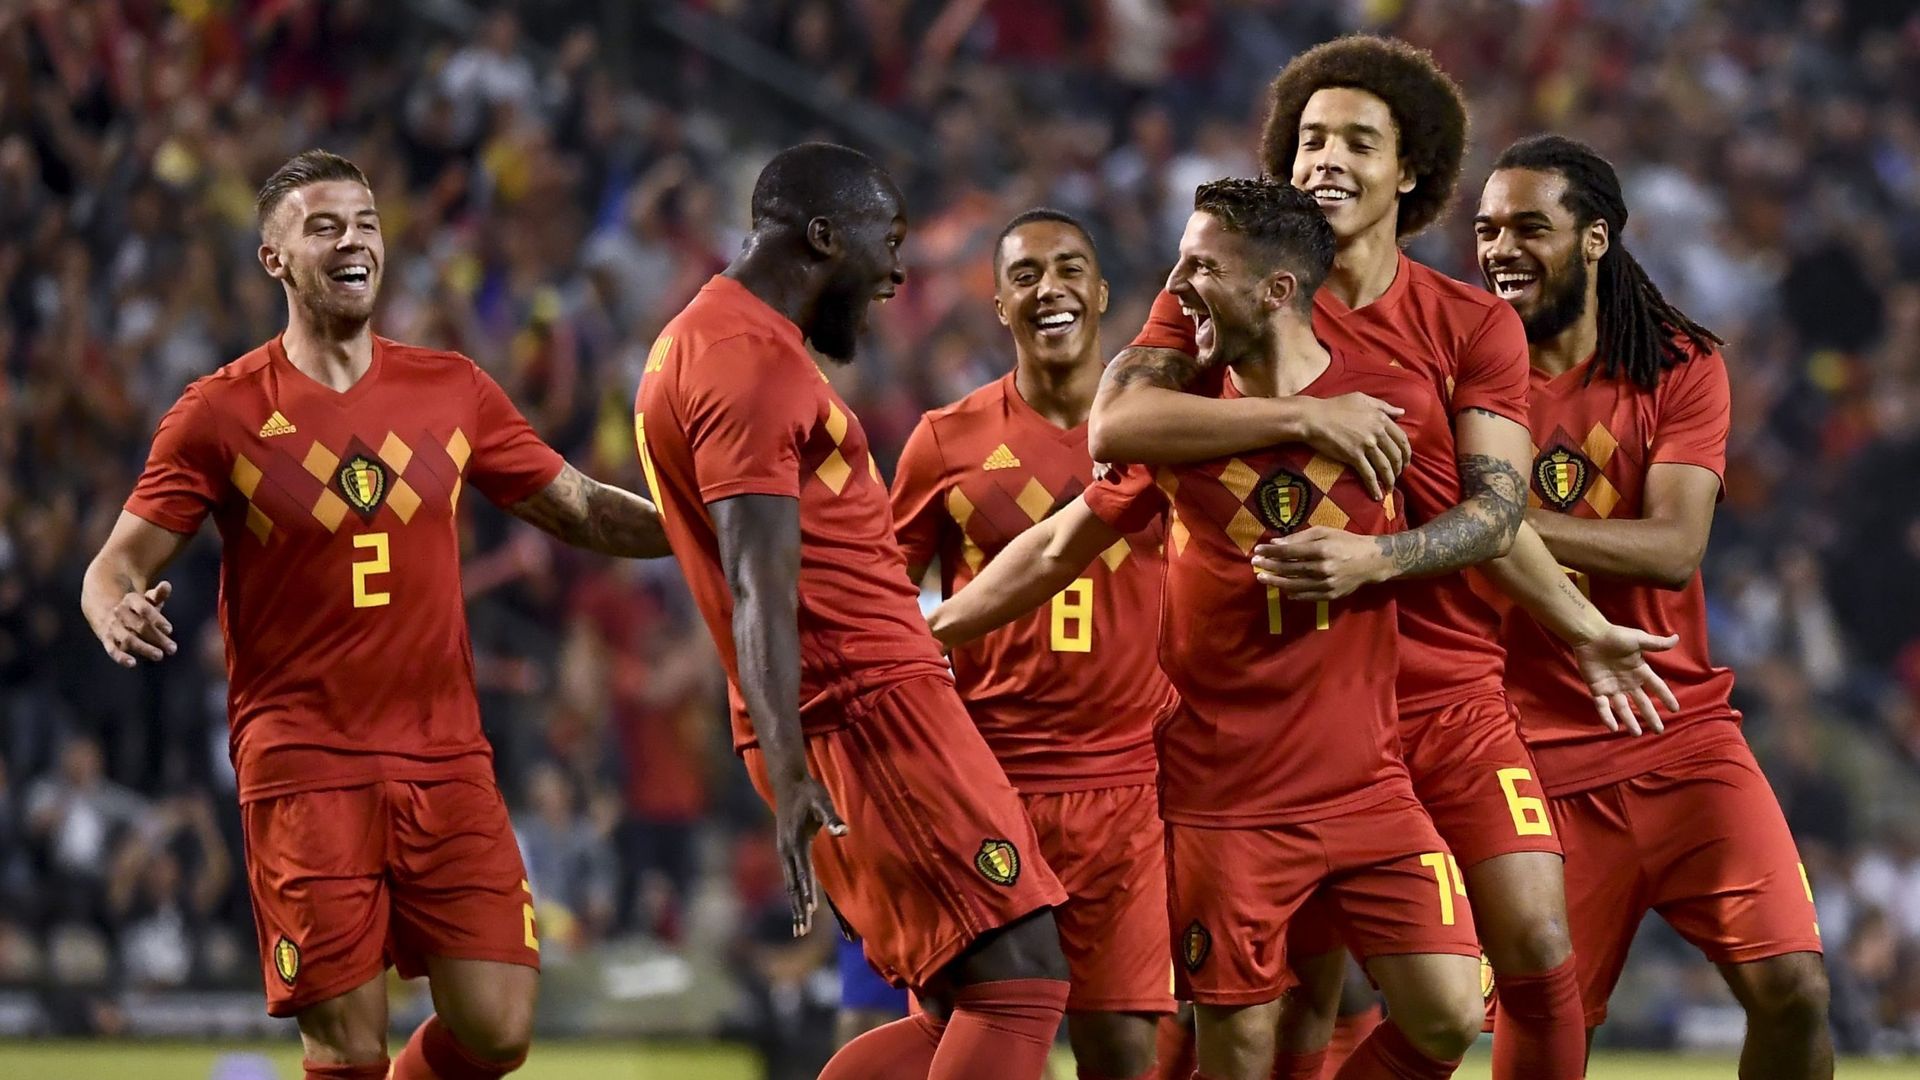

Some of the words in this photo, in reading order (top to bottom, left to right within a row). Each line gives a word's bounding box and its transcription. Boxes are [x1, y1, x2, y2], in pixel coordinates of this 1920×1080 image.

[259, 424, 297, 438] adidas
[352, 532, 390, 608] 2
[1051, 577, 1093, 653] 8
[1496, 767, 1552, 836] 6
